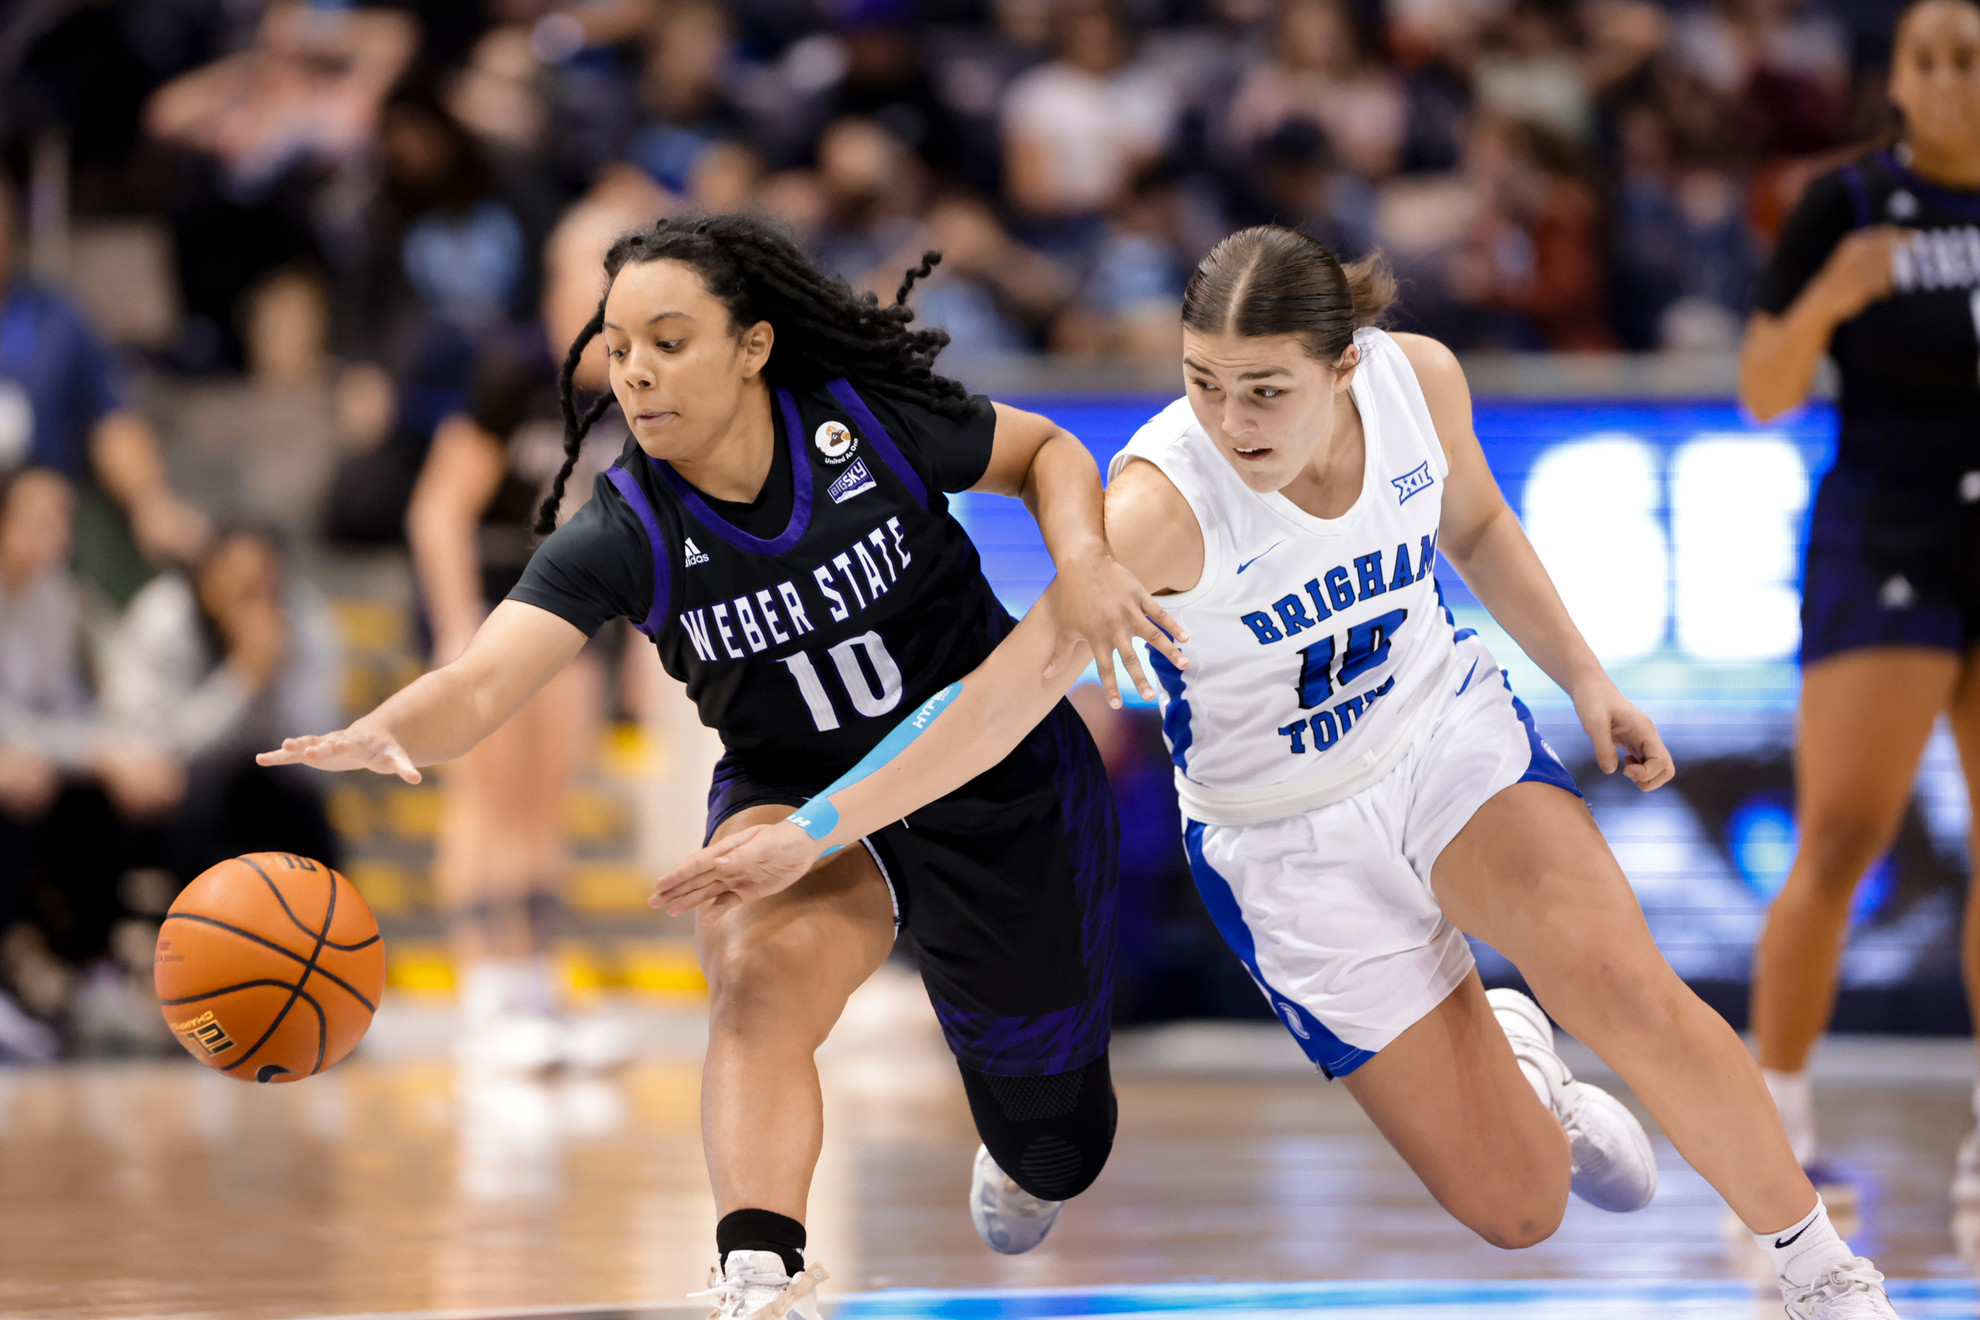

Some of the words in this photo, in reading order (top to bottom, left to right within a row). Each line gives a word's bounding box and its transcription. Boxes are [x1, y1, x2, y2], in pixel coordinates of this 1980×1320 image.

[679, 580, 815, 661] WEBER
[812, 515, 912, 623] STATE
[1240, 527, 1438, 646] BRIGHAM
[774, 629, 904, 733] 10
